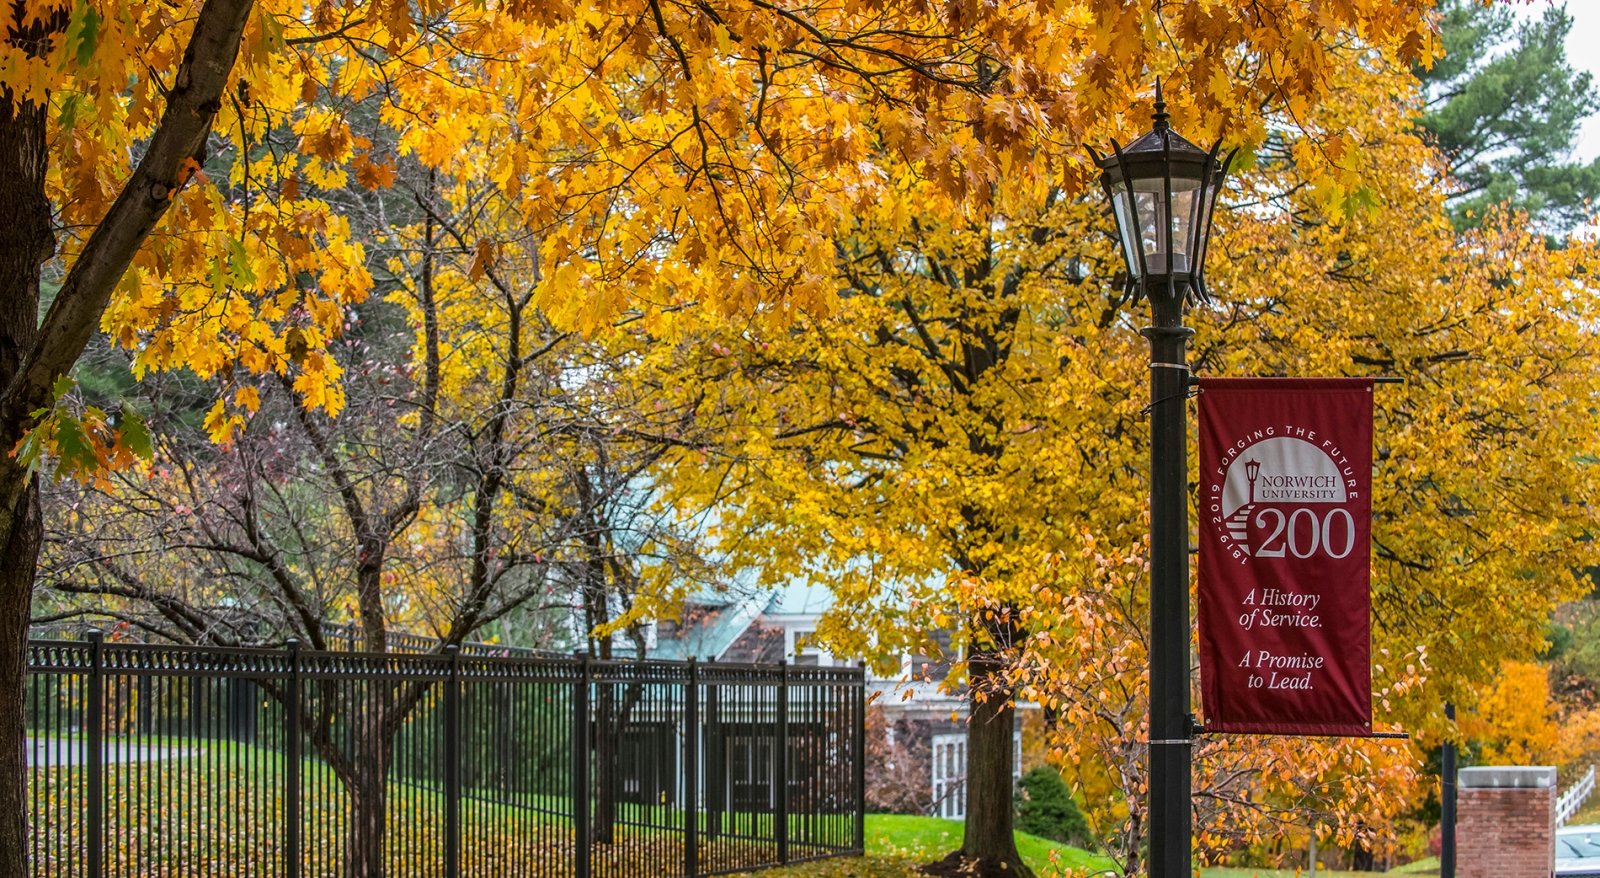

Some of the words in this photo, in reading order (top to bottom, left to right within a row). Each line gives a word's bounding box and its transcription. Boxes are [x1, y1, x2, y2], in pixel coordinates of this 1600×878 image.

[1218, 426, 1274, 475] FORGING
[1286, 426, 1315, 440] THE
[1322, 439, 1358, 499] FUTURE
[1262, 476, 1336, 488] NORWICH
[1262, 490, 1336, 498] UNIVERSITY
[1211, 484, 1247, 564] 1819-2019
[1255, 508, 1356, 559] 200
[1243, 589, 1255, 605] A
[1260, 588, 1320, 610] History
[1239, 609, 1258, 630] of
[1260, 610, 1322, 628] Service.
[1239, 651, 1251, 668] A
[1256, 651, 1323, 669] Promise
[1248, 674, 1263, 688] to
[1268, 672, 1313, 690] Lead.
